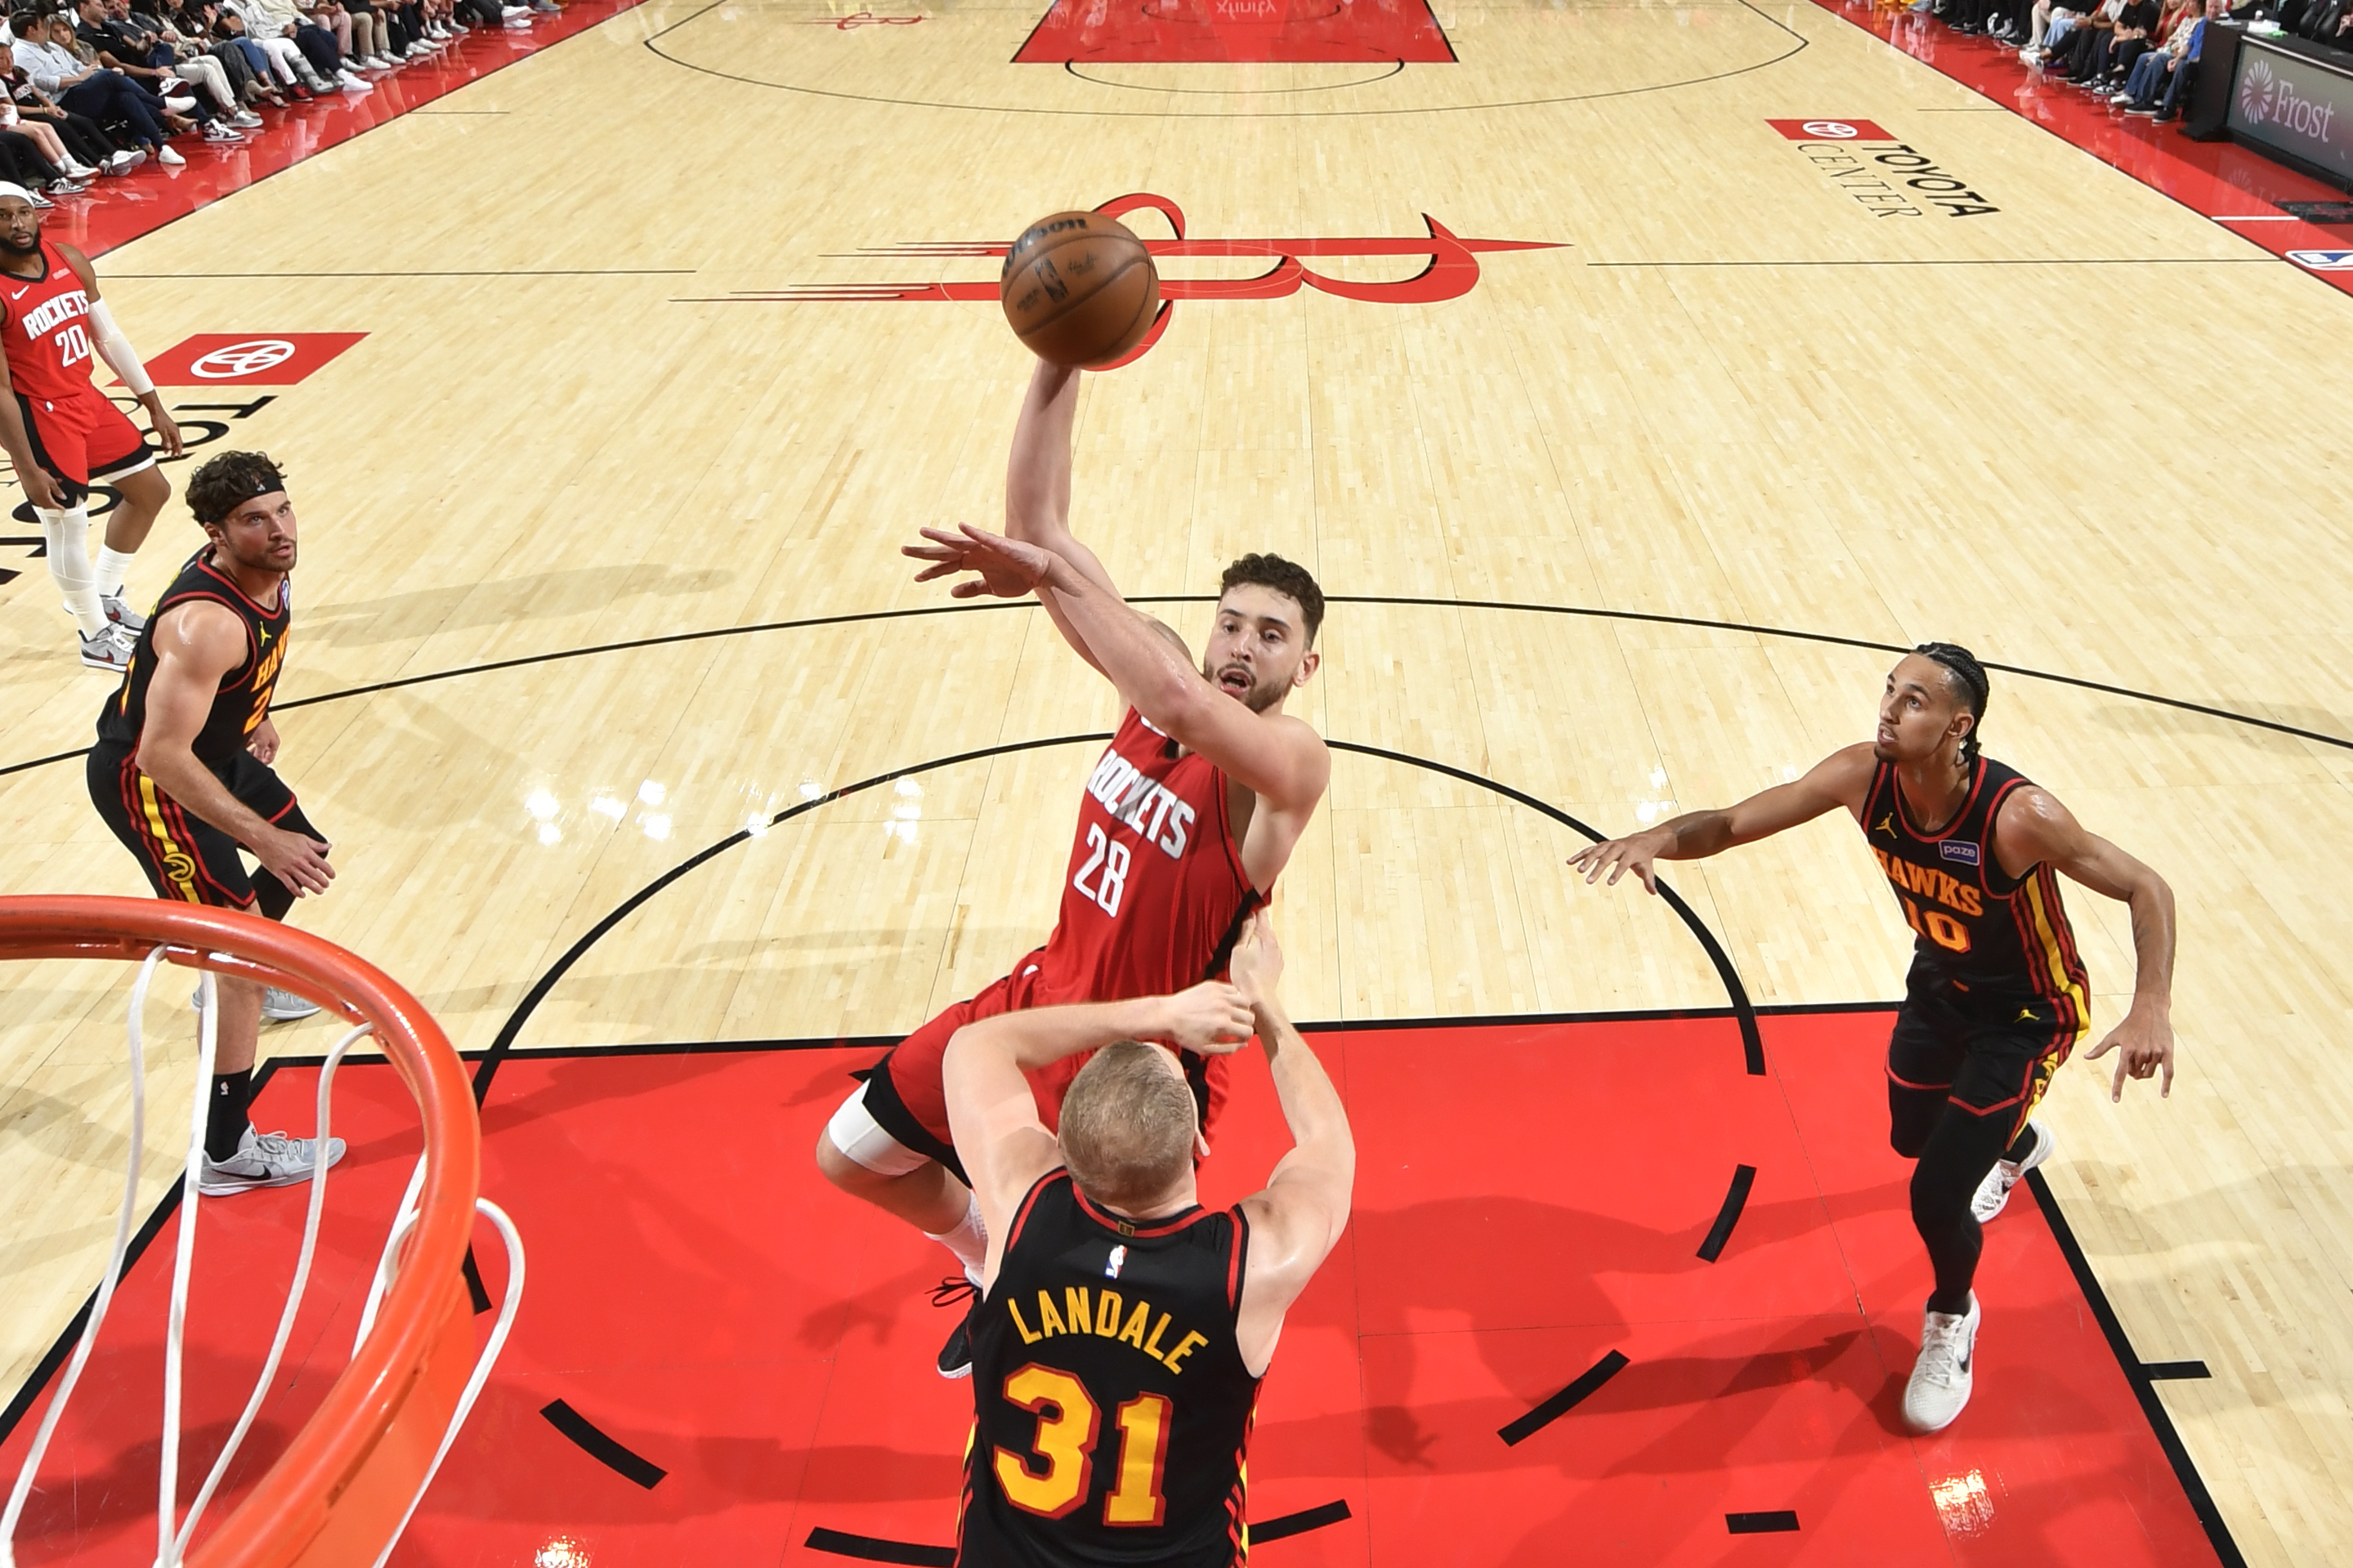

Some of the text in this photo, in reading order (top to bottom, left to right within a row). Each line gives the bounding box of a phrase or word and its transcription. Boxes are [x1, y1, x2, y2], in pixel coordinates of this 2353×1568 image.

[2271, 79, 2335, 143] Frost
[1797, 143, 1923, 217] CENTER
[1861, 144, 2002, 217] TOYOTA
[22, 289, 89, 341] ROCKETS
[55, 324, 89, 368] 20
[1086, 748, 1196, 860] ROCKETS
[1072, 821, 1131, 918] 28
[1870, 843, 1984, 918] HAWKS
[1943, 844, 1976, 858] paze
[1903, 894, 1972, 954] 10
[1007, 1285, 1209, 1375] LANDALE
[992, 1361, 1174, 1527] 31
